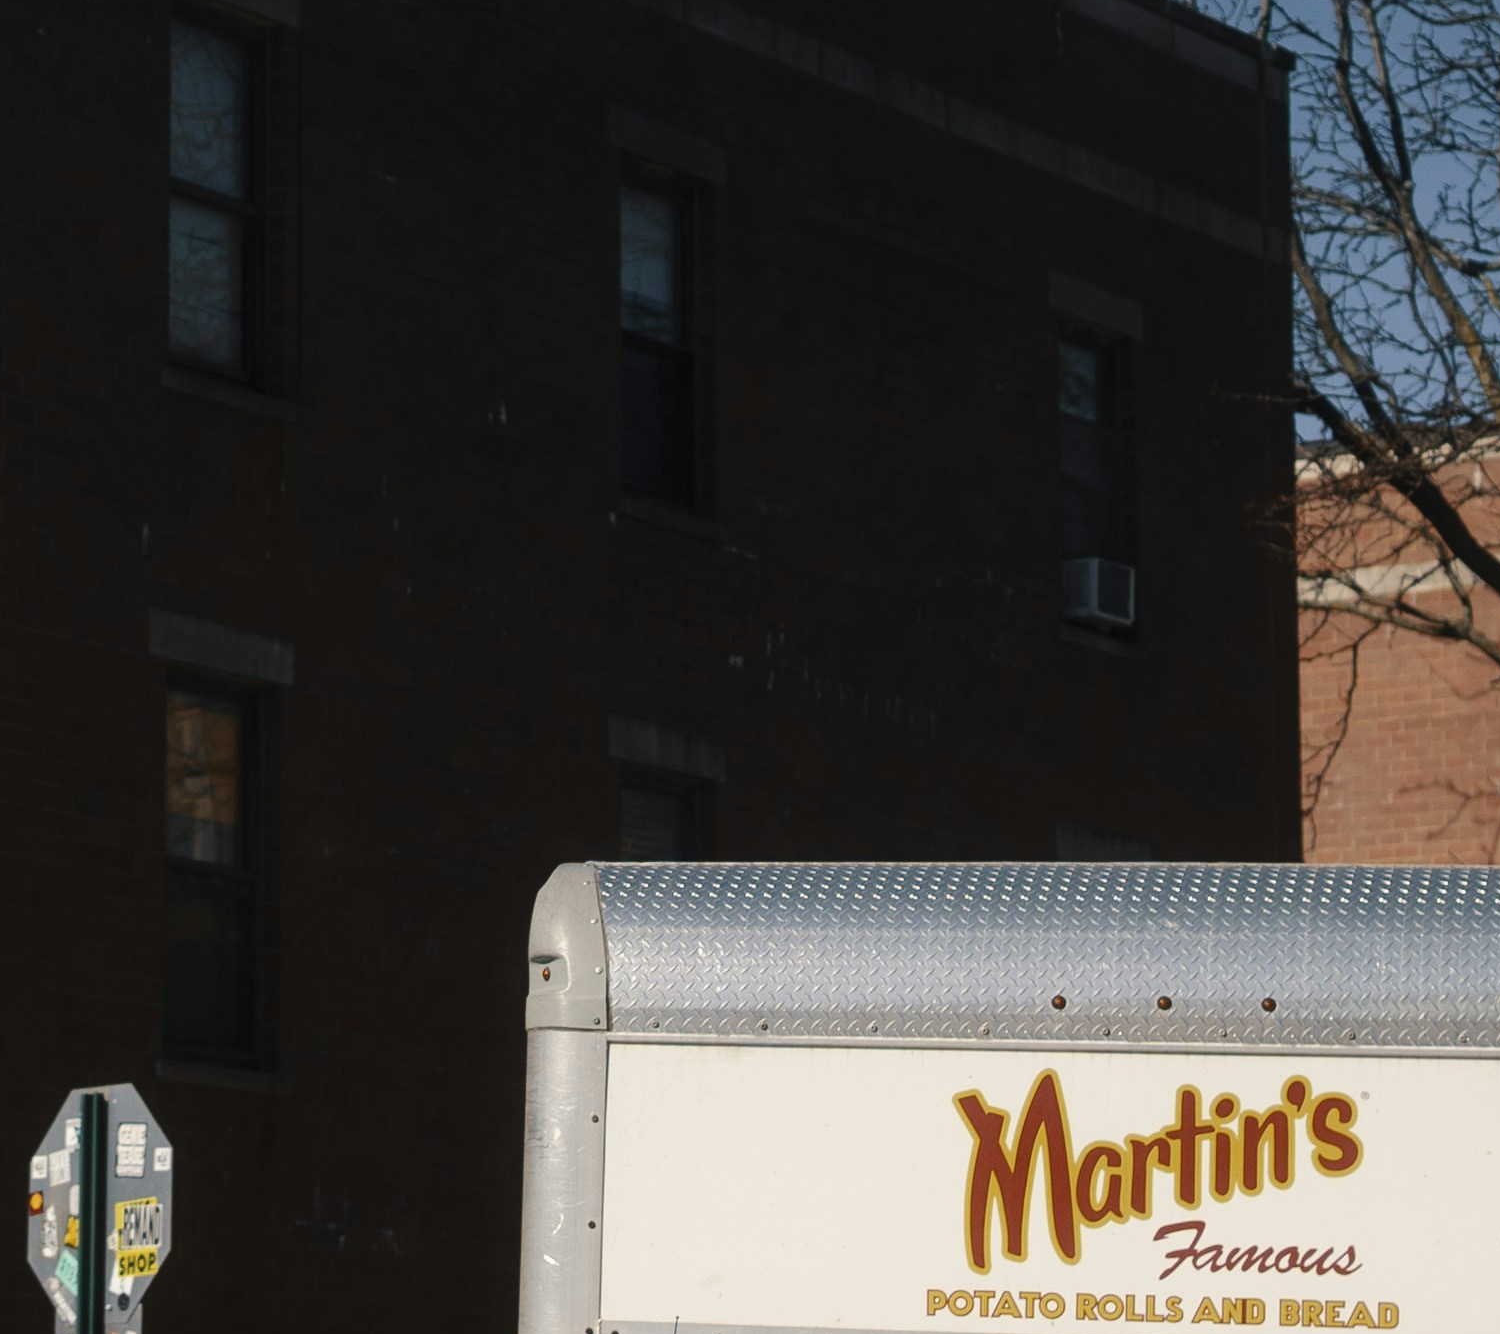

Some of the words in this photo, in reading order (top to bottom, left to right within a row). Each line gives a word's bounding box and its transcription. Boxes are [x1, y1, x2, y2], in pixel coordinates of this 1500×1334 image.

[951, 1067, 1364, 1276] Martin's
[118, 1252, 157, 1276] SHOP
[1152, 1219, 1364, 1281] Famous
[926, 1289, 1065, 1319] POTATO
[1075, 1292, 1184, 1324] ROLLS
[1191, 1296, 1266, 1326] AND
[1279, 1299, 1400, 1330] BREAD
